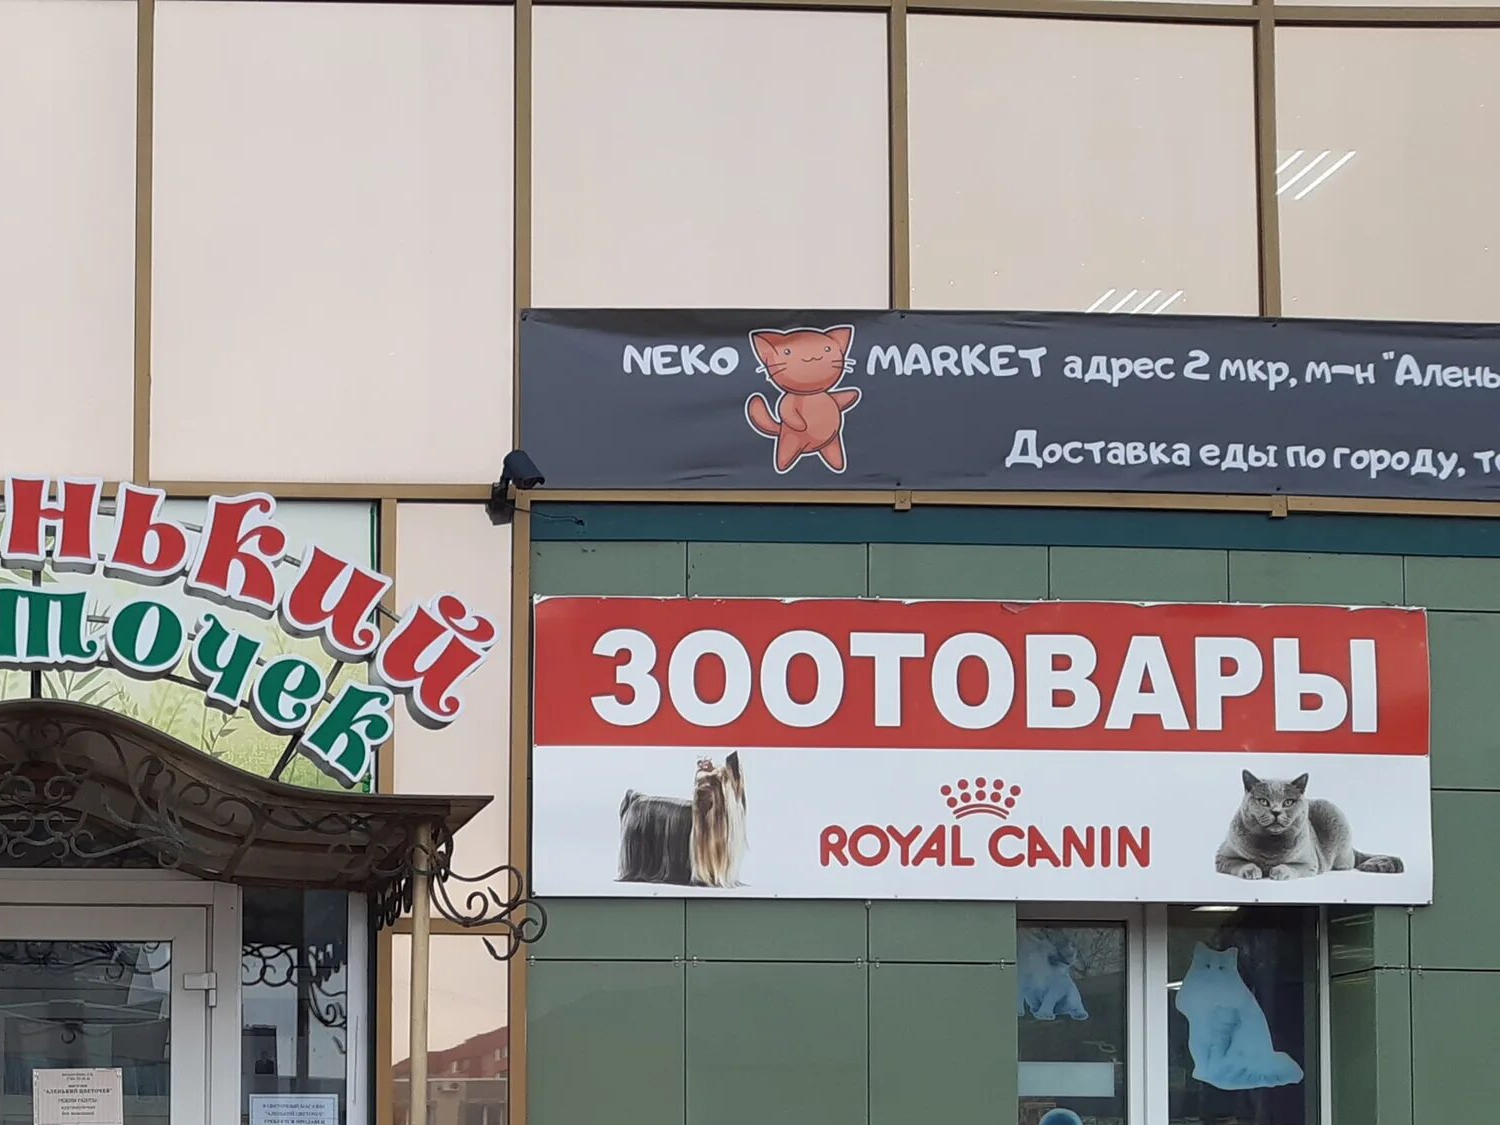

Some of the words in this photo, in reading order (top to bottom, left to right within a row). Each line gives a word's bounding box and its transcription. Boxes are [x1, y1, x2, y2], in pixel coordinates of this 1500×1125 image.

[622, 344, 740, 376] NEKO
[866, 343, 1048, 377] MARKET
[1063, 355, 1175, 387] адрес
[1182, 350, 1211, 380] 2
[1219, 358, 1298, 391] мкр,
[1005, 430, 1191, 469] Доставка
[1199, 443, 1279, 472] еды
[1286, 445, 1326, 468] по
[1333, 448, 1467, 480] городу,
[590, 628, 1378, 733] ЗООТОВАРЫ
[820, 824, 975, 868] ROYAL
[987, 824, 1151, 869] CANIN
